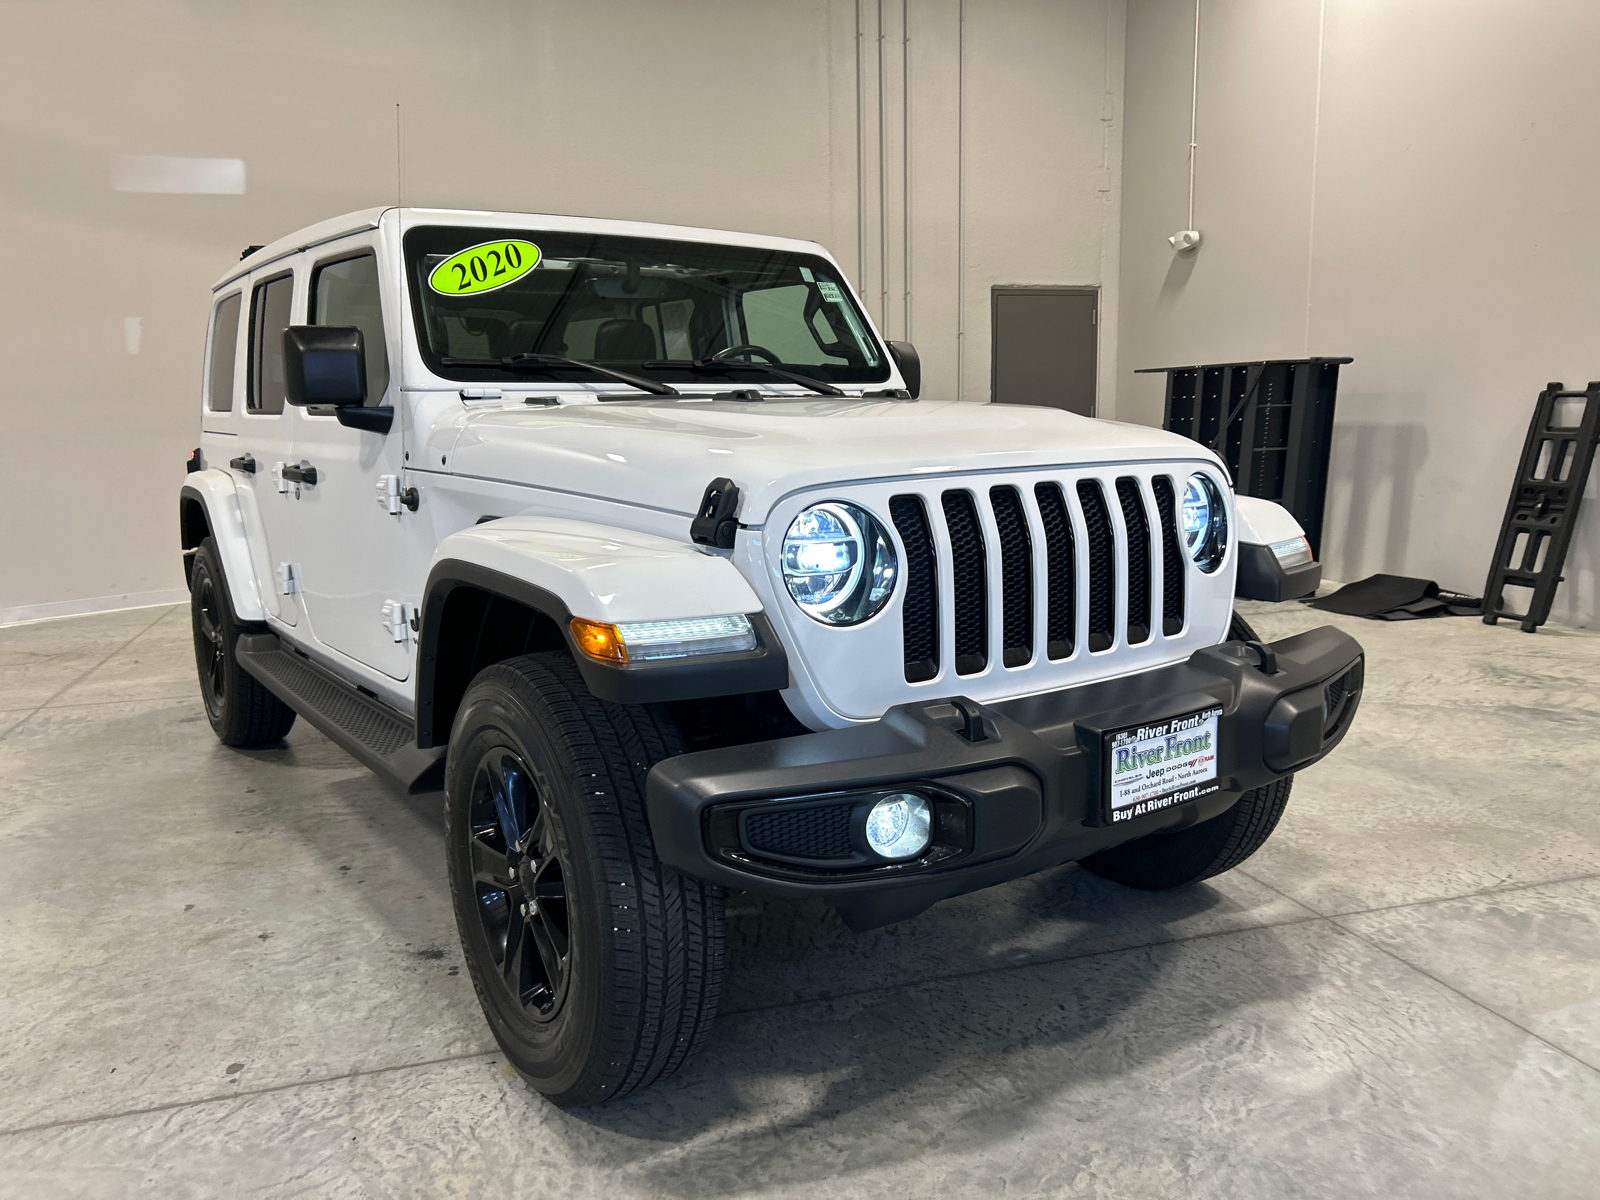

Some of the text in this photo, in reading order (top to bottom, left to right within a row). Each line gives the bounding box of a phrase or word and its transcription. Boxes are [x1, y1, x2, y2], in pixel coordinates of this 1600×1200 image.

[452, 243, 522, 291] 2020
[1136, 714, 1200, 742] River Front
[1131, 785, 1141, 794] and
[1141, 778, 1162, 791] Orchard
[1162, 774, 1175, 785] Road
[1177, 770, 1192, 781] North
[1192, 767, 1208, 777] Aurora
[1146, 768, 1165, 780] Jeep
[1166, 760, 1193, 773] DODGE
[1112, 808, 1133, 822] Buy
[1134, 803, 1147, 816] At
